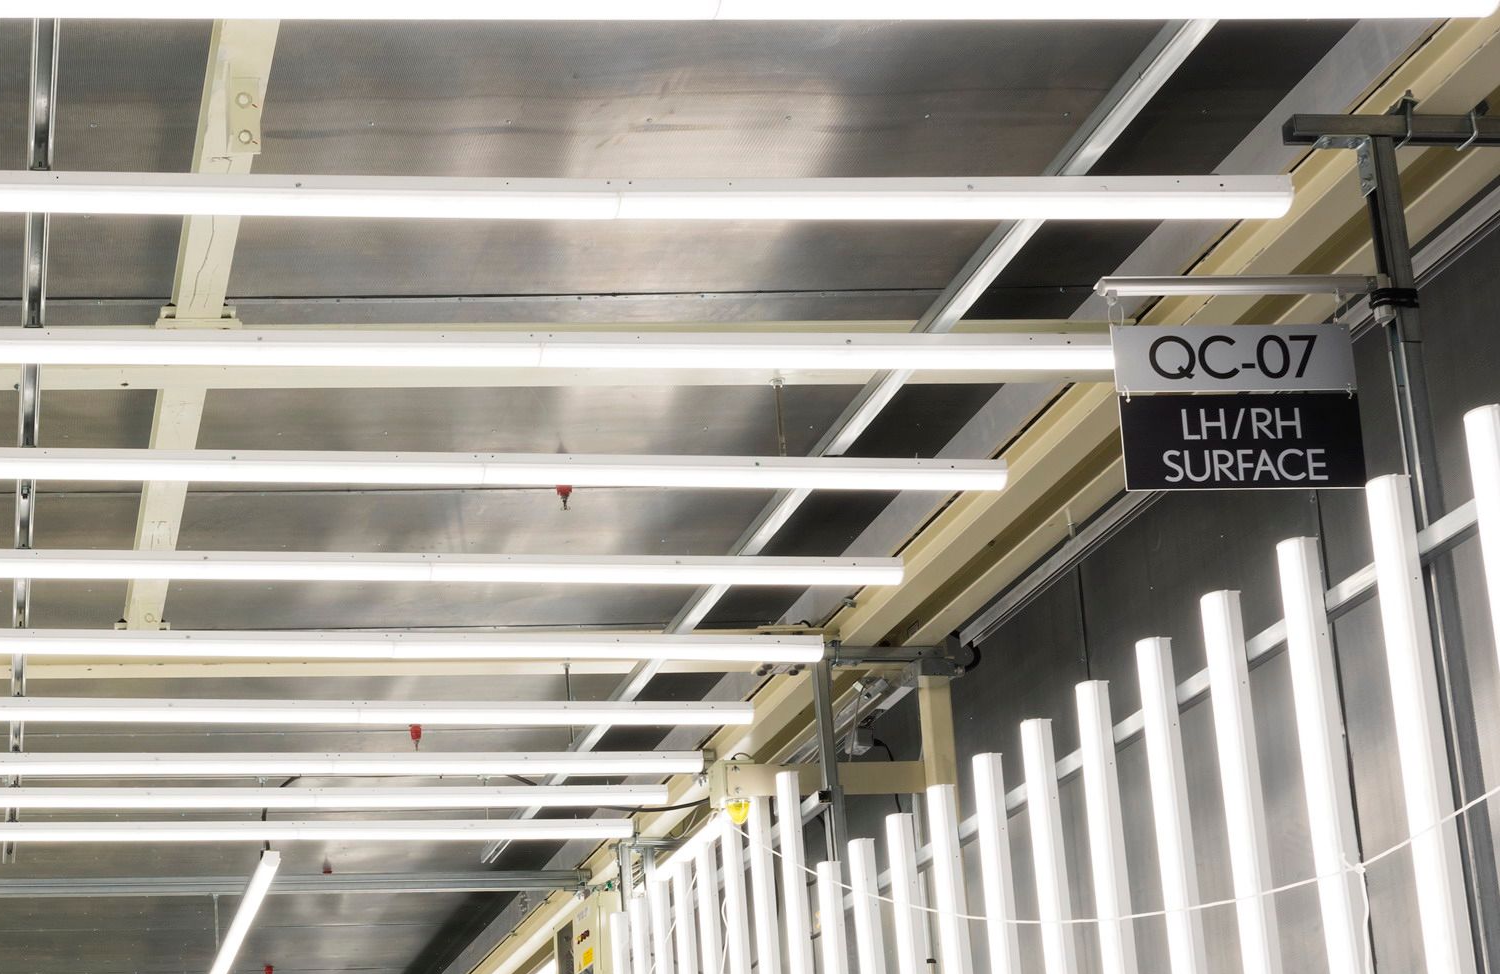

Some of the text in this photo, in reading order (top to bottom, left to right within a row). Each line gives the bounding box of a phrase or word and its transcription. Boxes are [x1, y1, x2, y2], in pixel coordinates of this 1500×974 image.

[1149, 334, 1318, 380] QC-07
[1181, 407, 1303, 441] LH/RH
[1162, 448, 1329, 483] SURFACE
